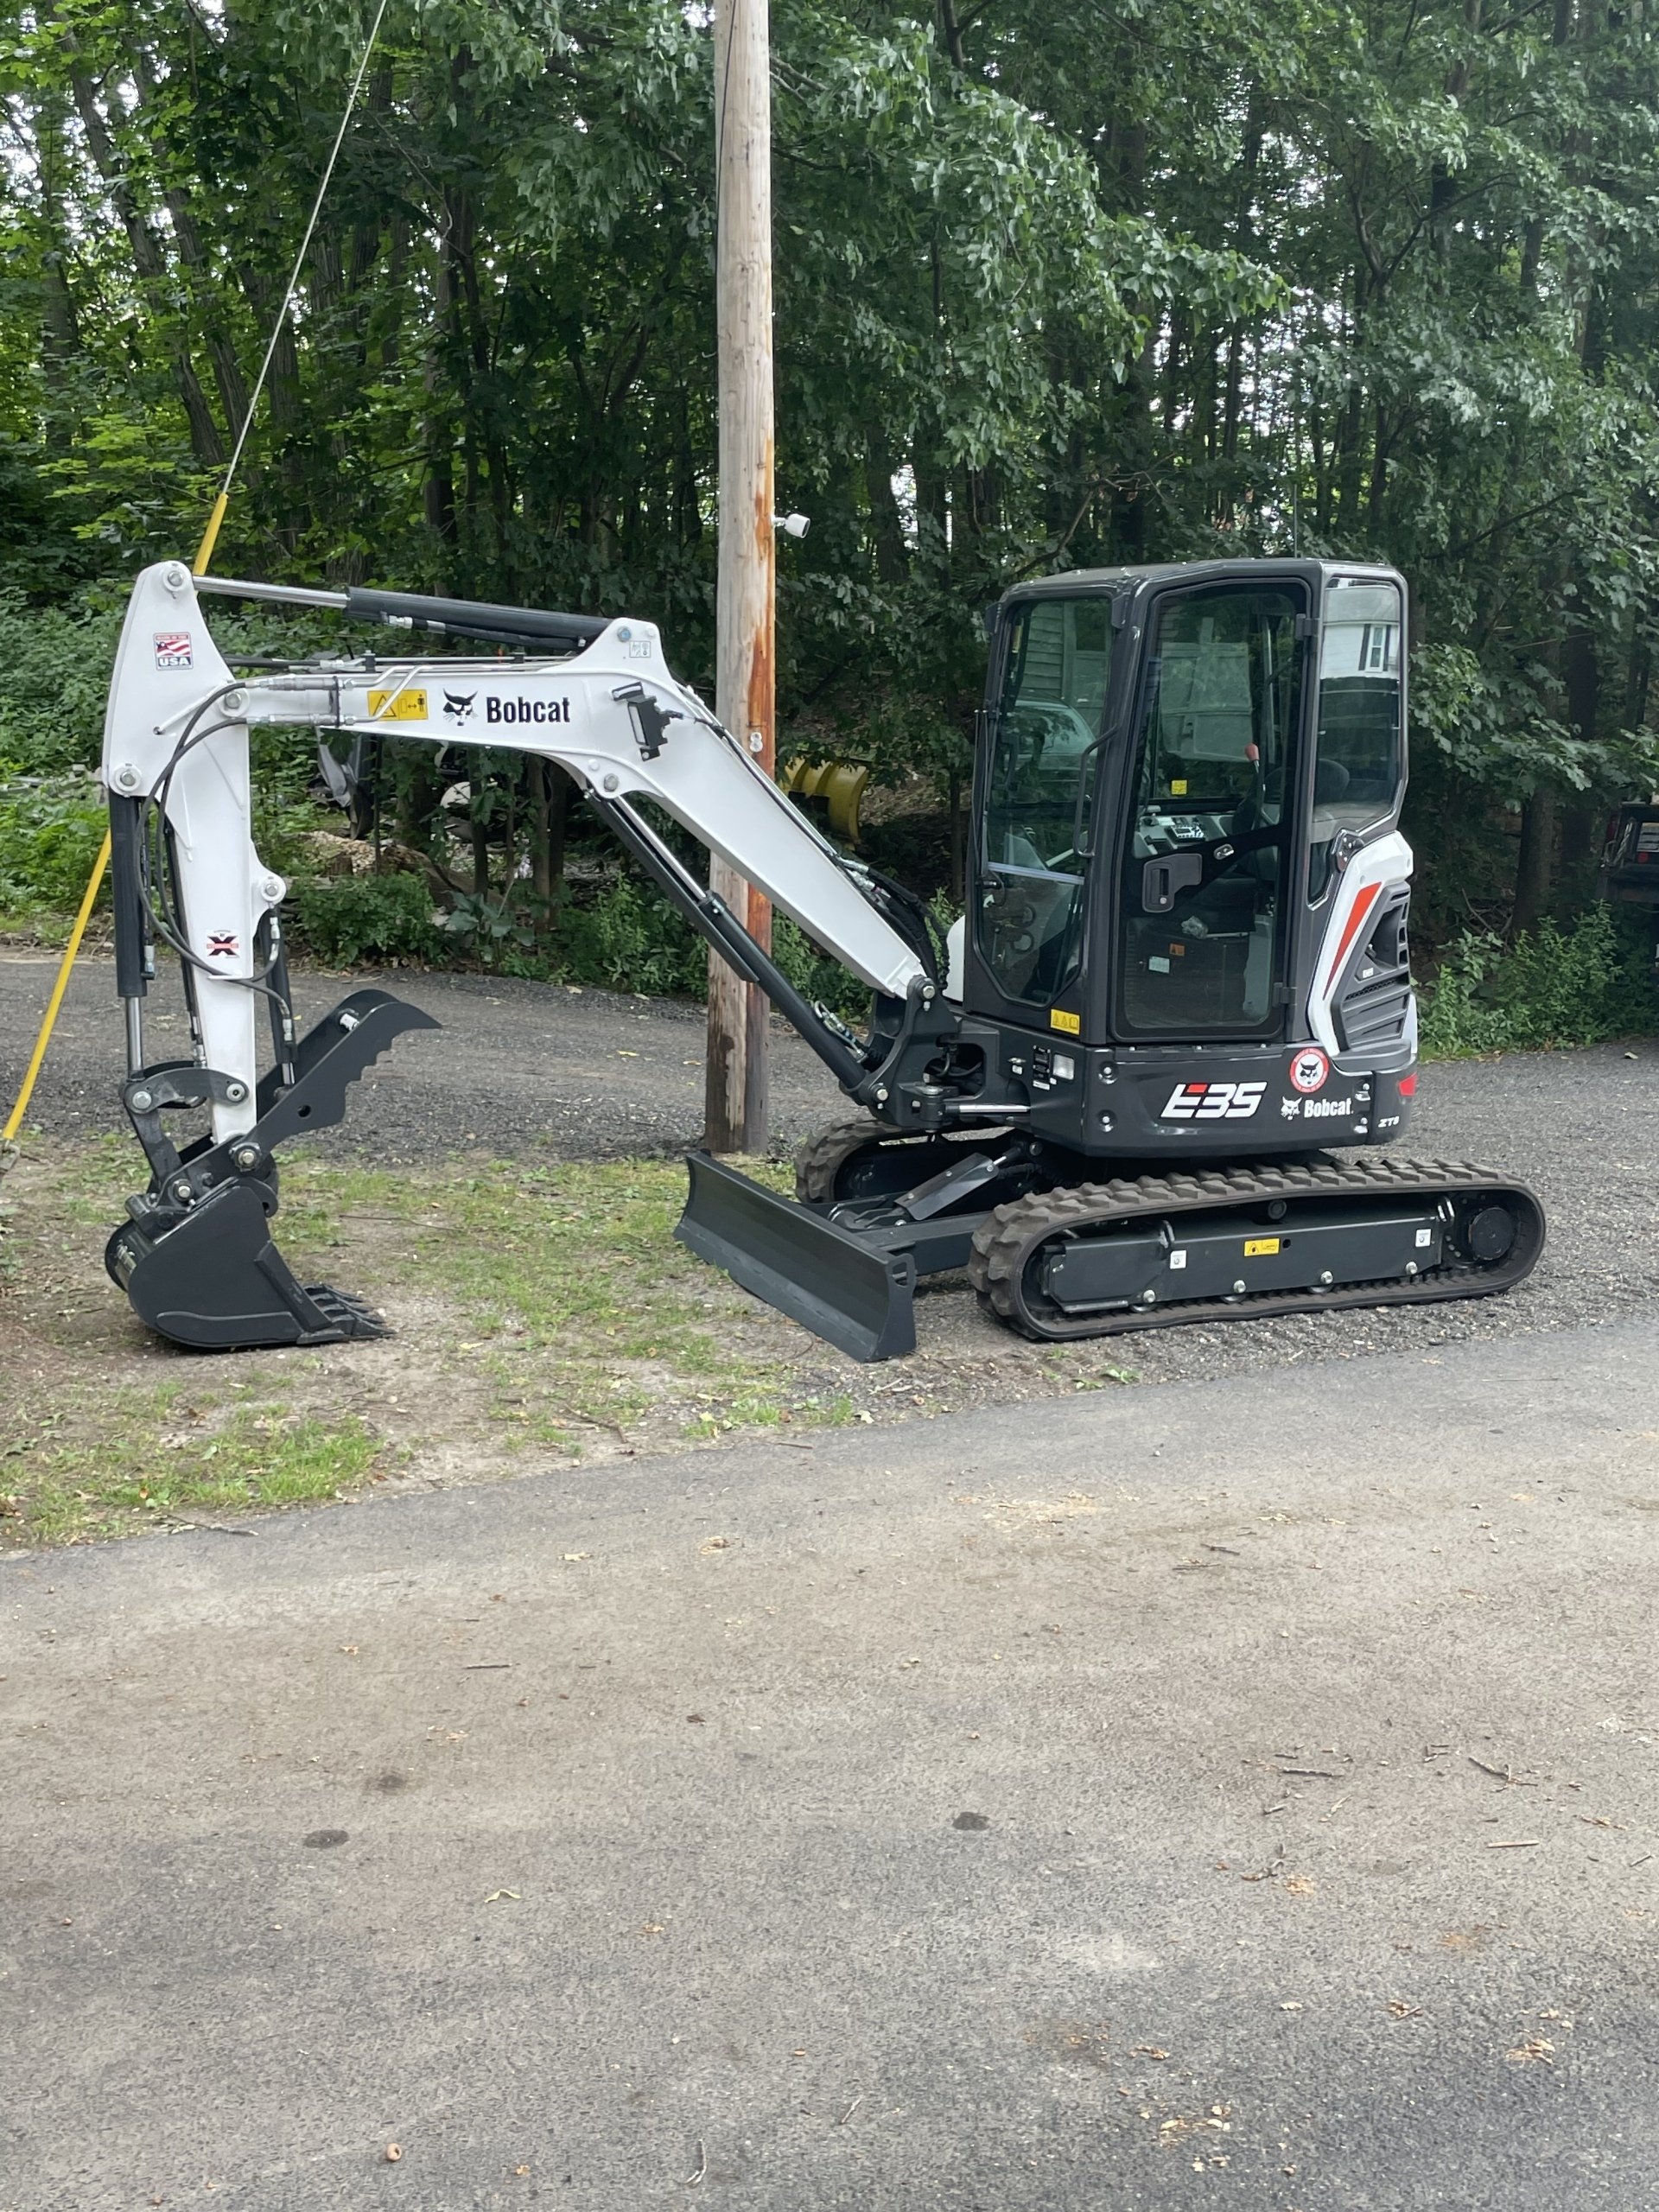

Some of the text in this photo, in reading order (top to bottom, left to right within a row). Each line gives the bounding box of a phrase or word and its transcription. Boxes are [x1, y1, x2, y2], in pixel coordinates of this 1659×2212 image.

[159, 657, 190, 666] USA
[486, 696, 570, 723] Bobcat
[1160, 1081, 1268, 1118] E35
[1304, 1097, 1353, 1118] Bobcat
